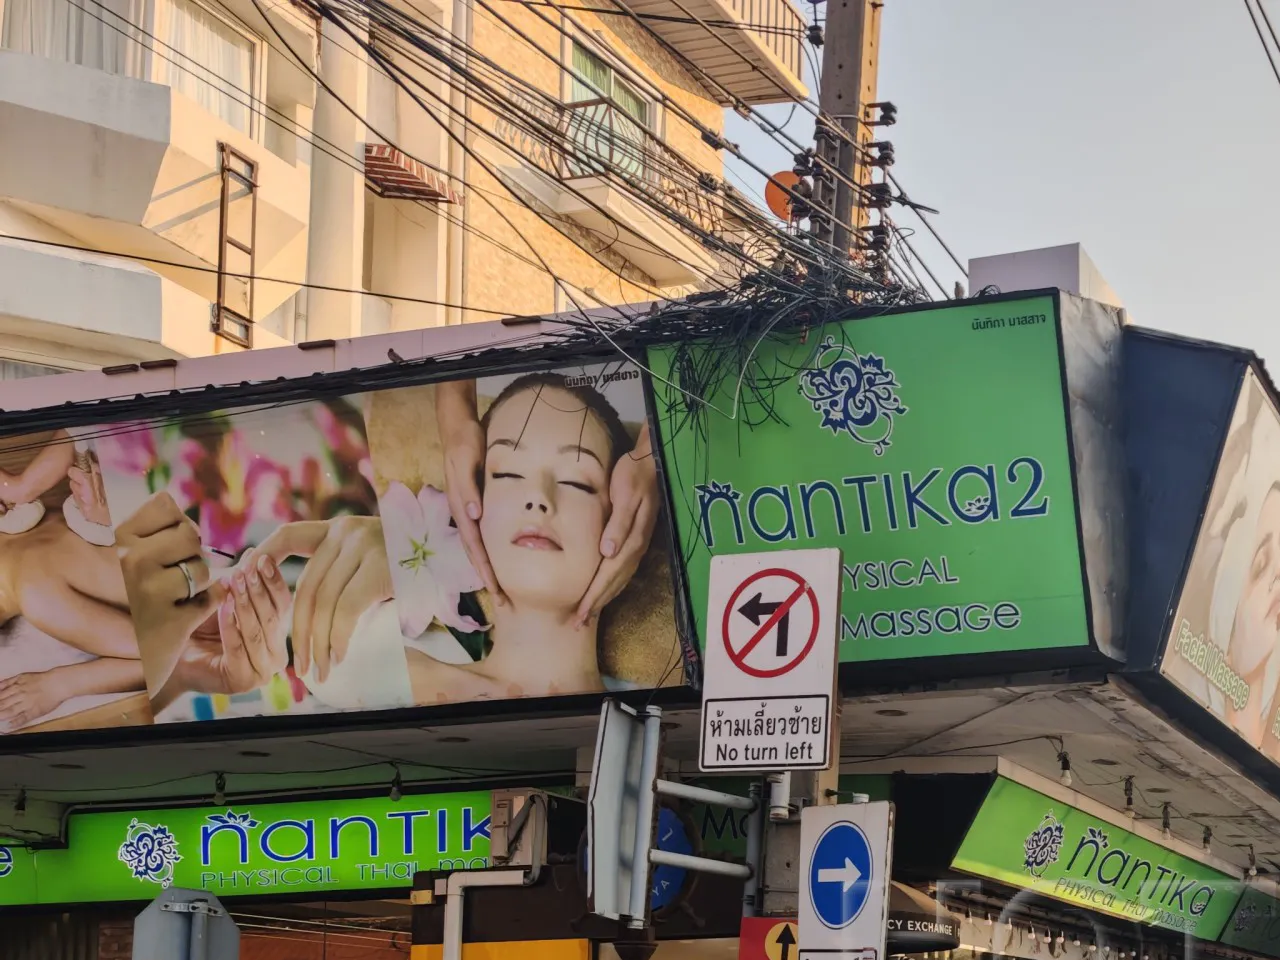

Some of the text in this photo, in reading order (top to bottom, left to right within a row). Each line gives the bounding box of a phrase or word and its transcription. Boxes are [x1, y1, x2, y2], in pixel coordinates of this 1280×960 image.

[842, 556, 959, 593] YSICAL
[709, 702, 822, 738] ห้ามเลี้ยวซ้าย
[716, 742, 813, 762] No turn left
[907, 920, 953, 936] EXCHANGE
